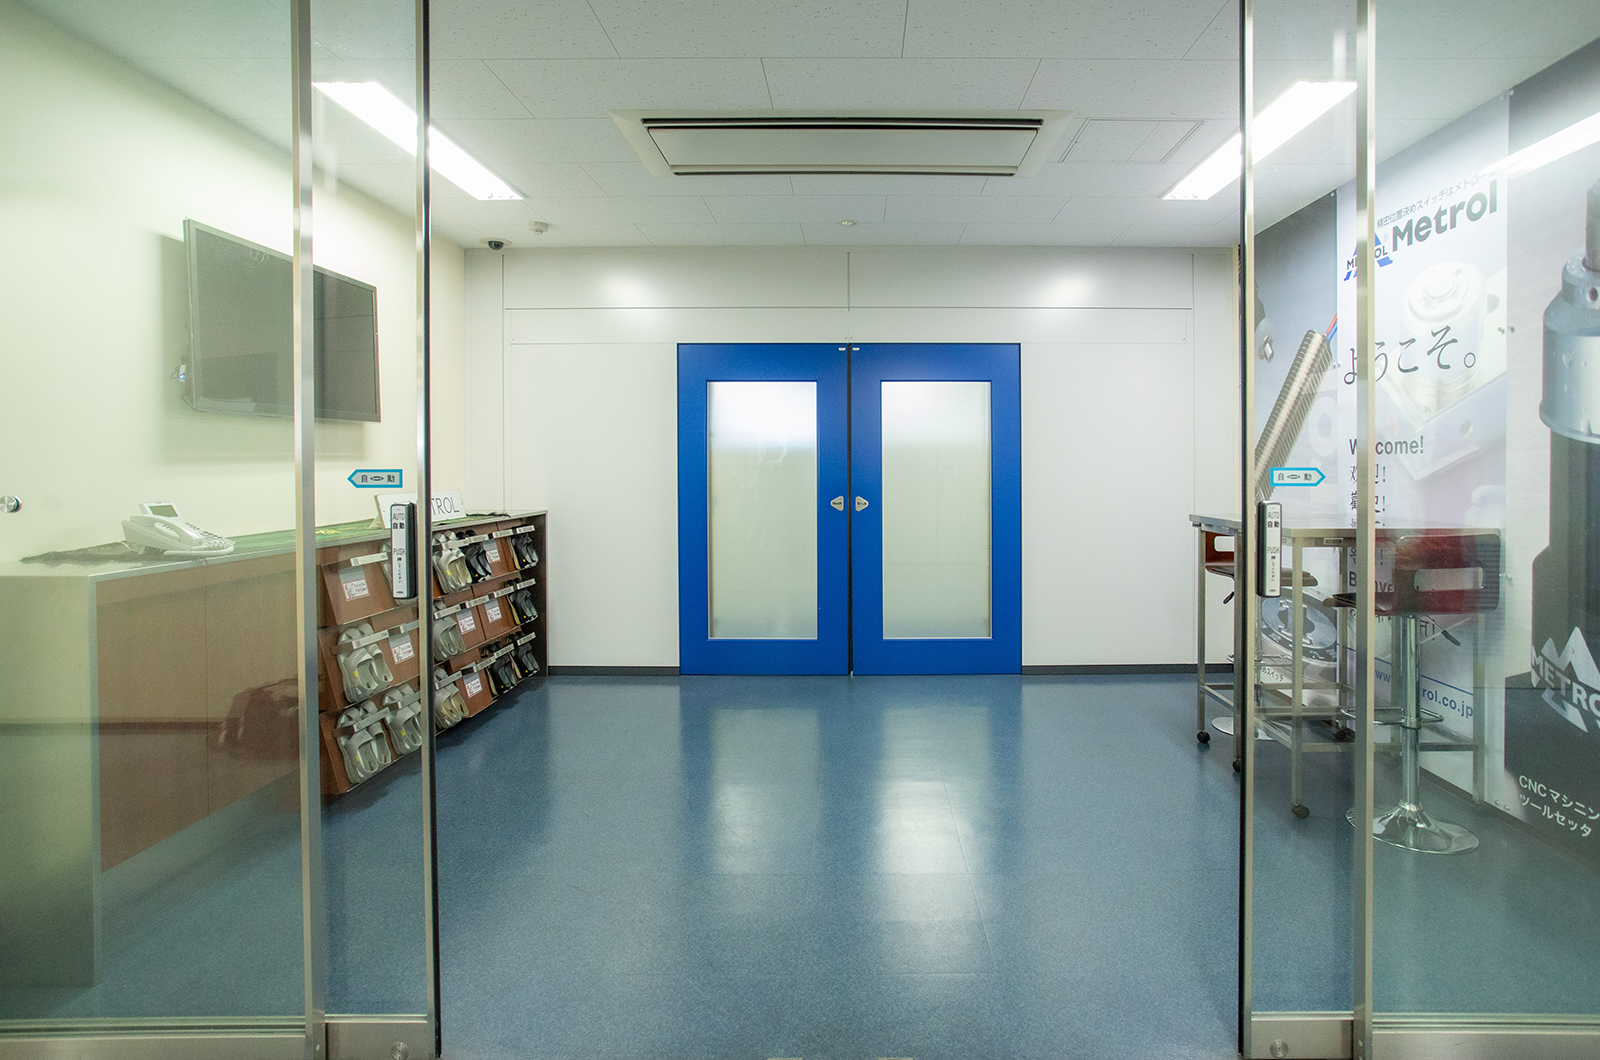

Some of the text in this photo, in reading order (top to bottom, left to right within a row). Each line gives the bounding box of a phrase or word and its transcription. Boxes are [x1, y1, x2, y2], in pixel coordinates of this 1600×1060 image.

[1392, 178, 1498, 252] Metrol
[1349, 435, 1424, 455] Wcome!
[430, 496, 460, 516] TROL
[393, 512, 405, 520] AUTO
[1267, 511, 1280, 519] AUTO
[1267, 520, 1280, 528] 自動
[393, 548, 405, 556] PUSH
[1267, 546, 1280, 554] PUSH
[1519, 775, 1547, 797] CNC
[1520, 793, 1592, 837] ツールセッタ
